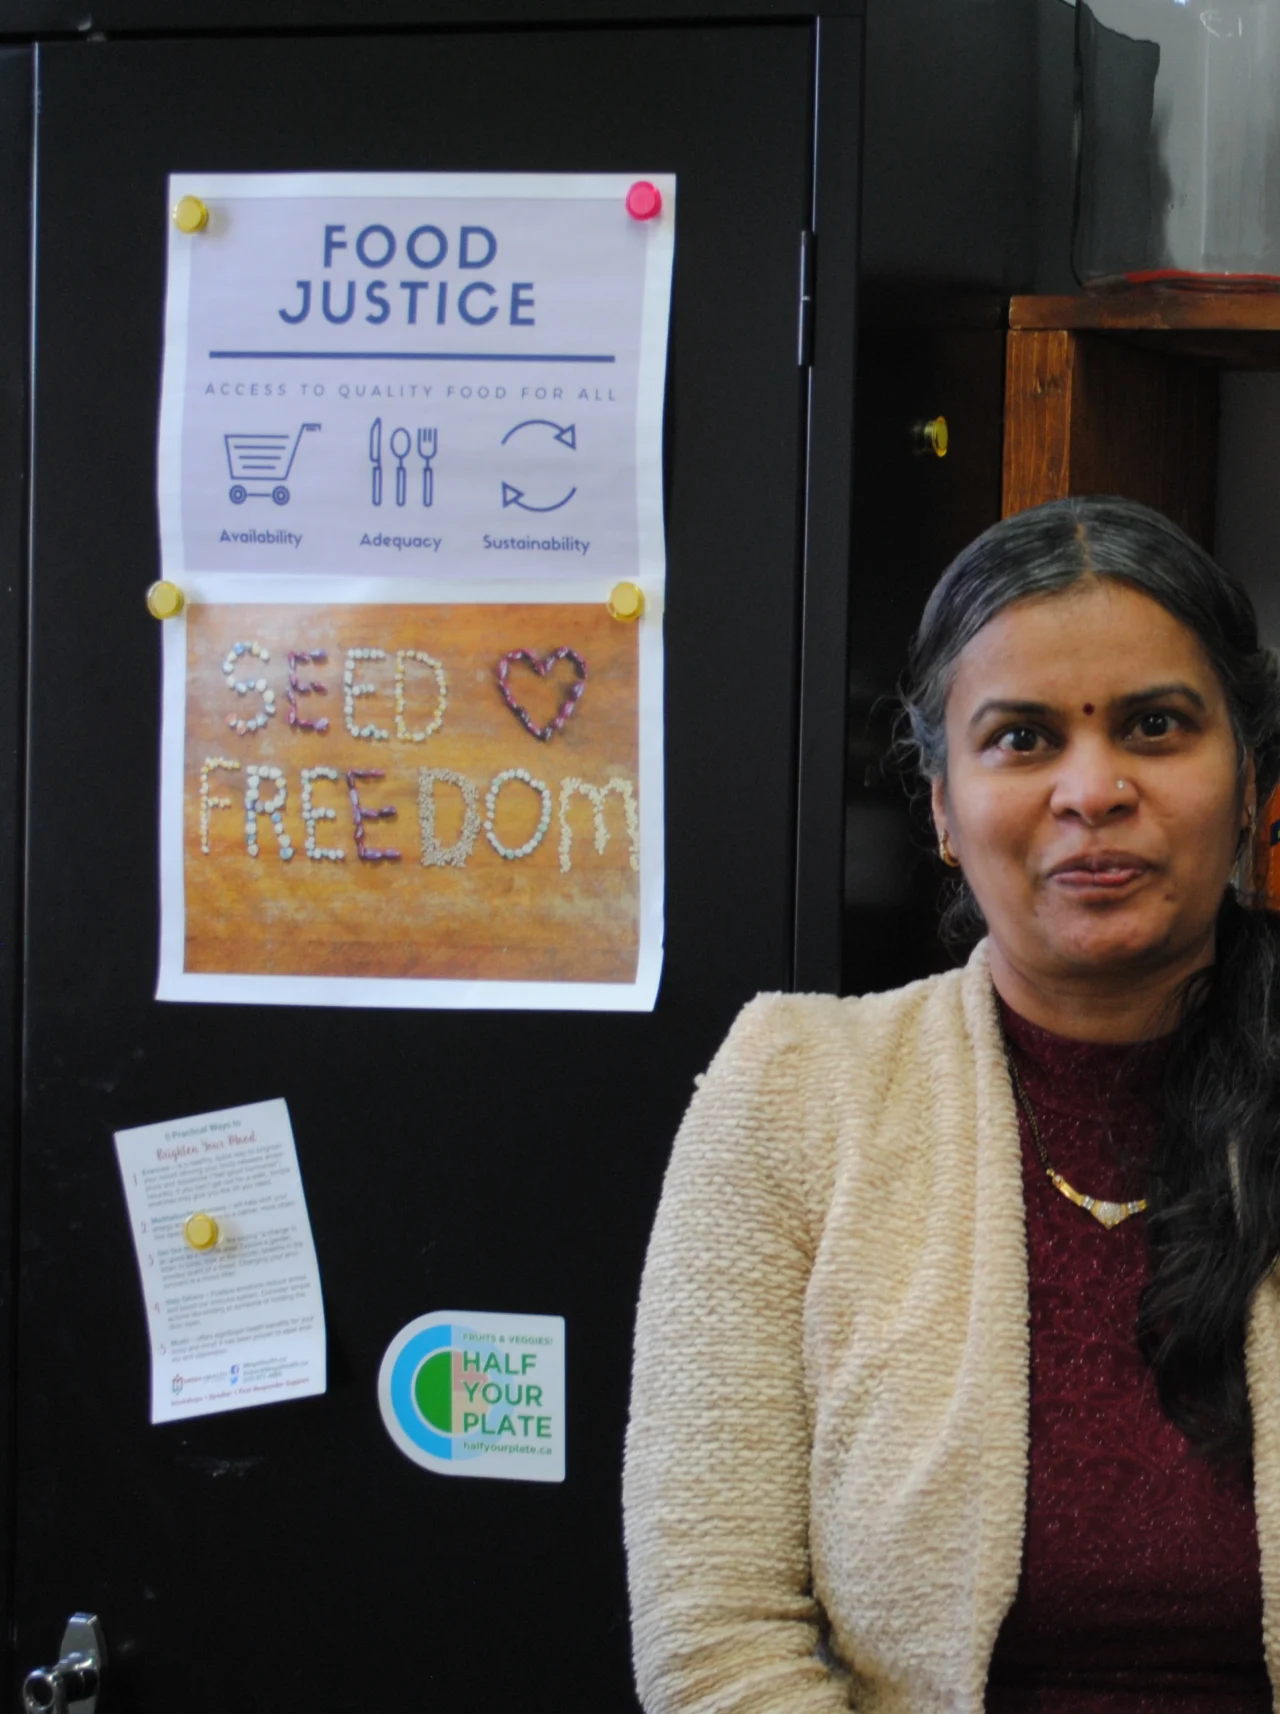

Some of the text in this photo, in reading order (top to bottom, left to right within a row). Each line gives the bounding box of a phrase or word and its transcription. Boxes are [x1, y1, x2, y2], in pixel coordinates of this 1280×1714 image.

[322, 223, 498, 270] FOOD
[278, 279, 536, 327] JUSTICE
[205, 382, 617, 402] ACCESS TO QUALITY FOOD FOR ALL
[219, 529, 303, 549] Availability
[359, 532, 442, 552] Adequacy
[482, 534, 591, 555] Sustainability
[222, 640, 447, 742] SEED
[199, 756, 640, 874] FREEDOM
[462, 1333, 496, 1343] FRUITS
[499, 1335, 505, 1344] &
[462, 1350, 537, 1376] HALF
[462, 1381, 544, 1407] YOUR
[462, 1412, 553, 1438] PLATE
[463, 1441, 553, 1456] halfyourplate.ca
